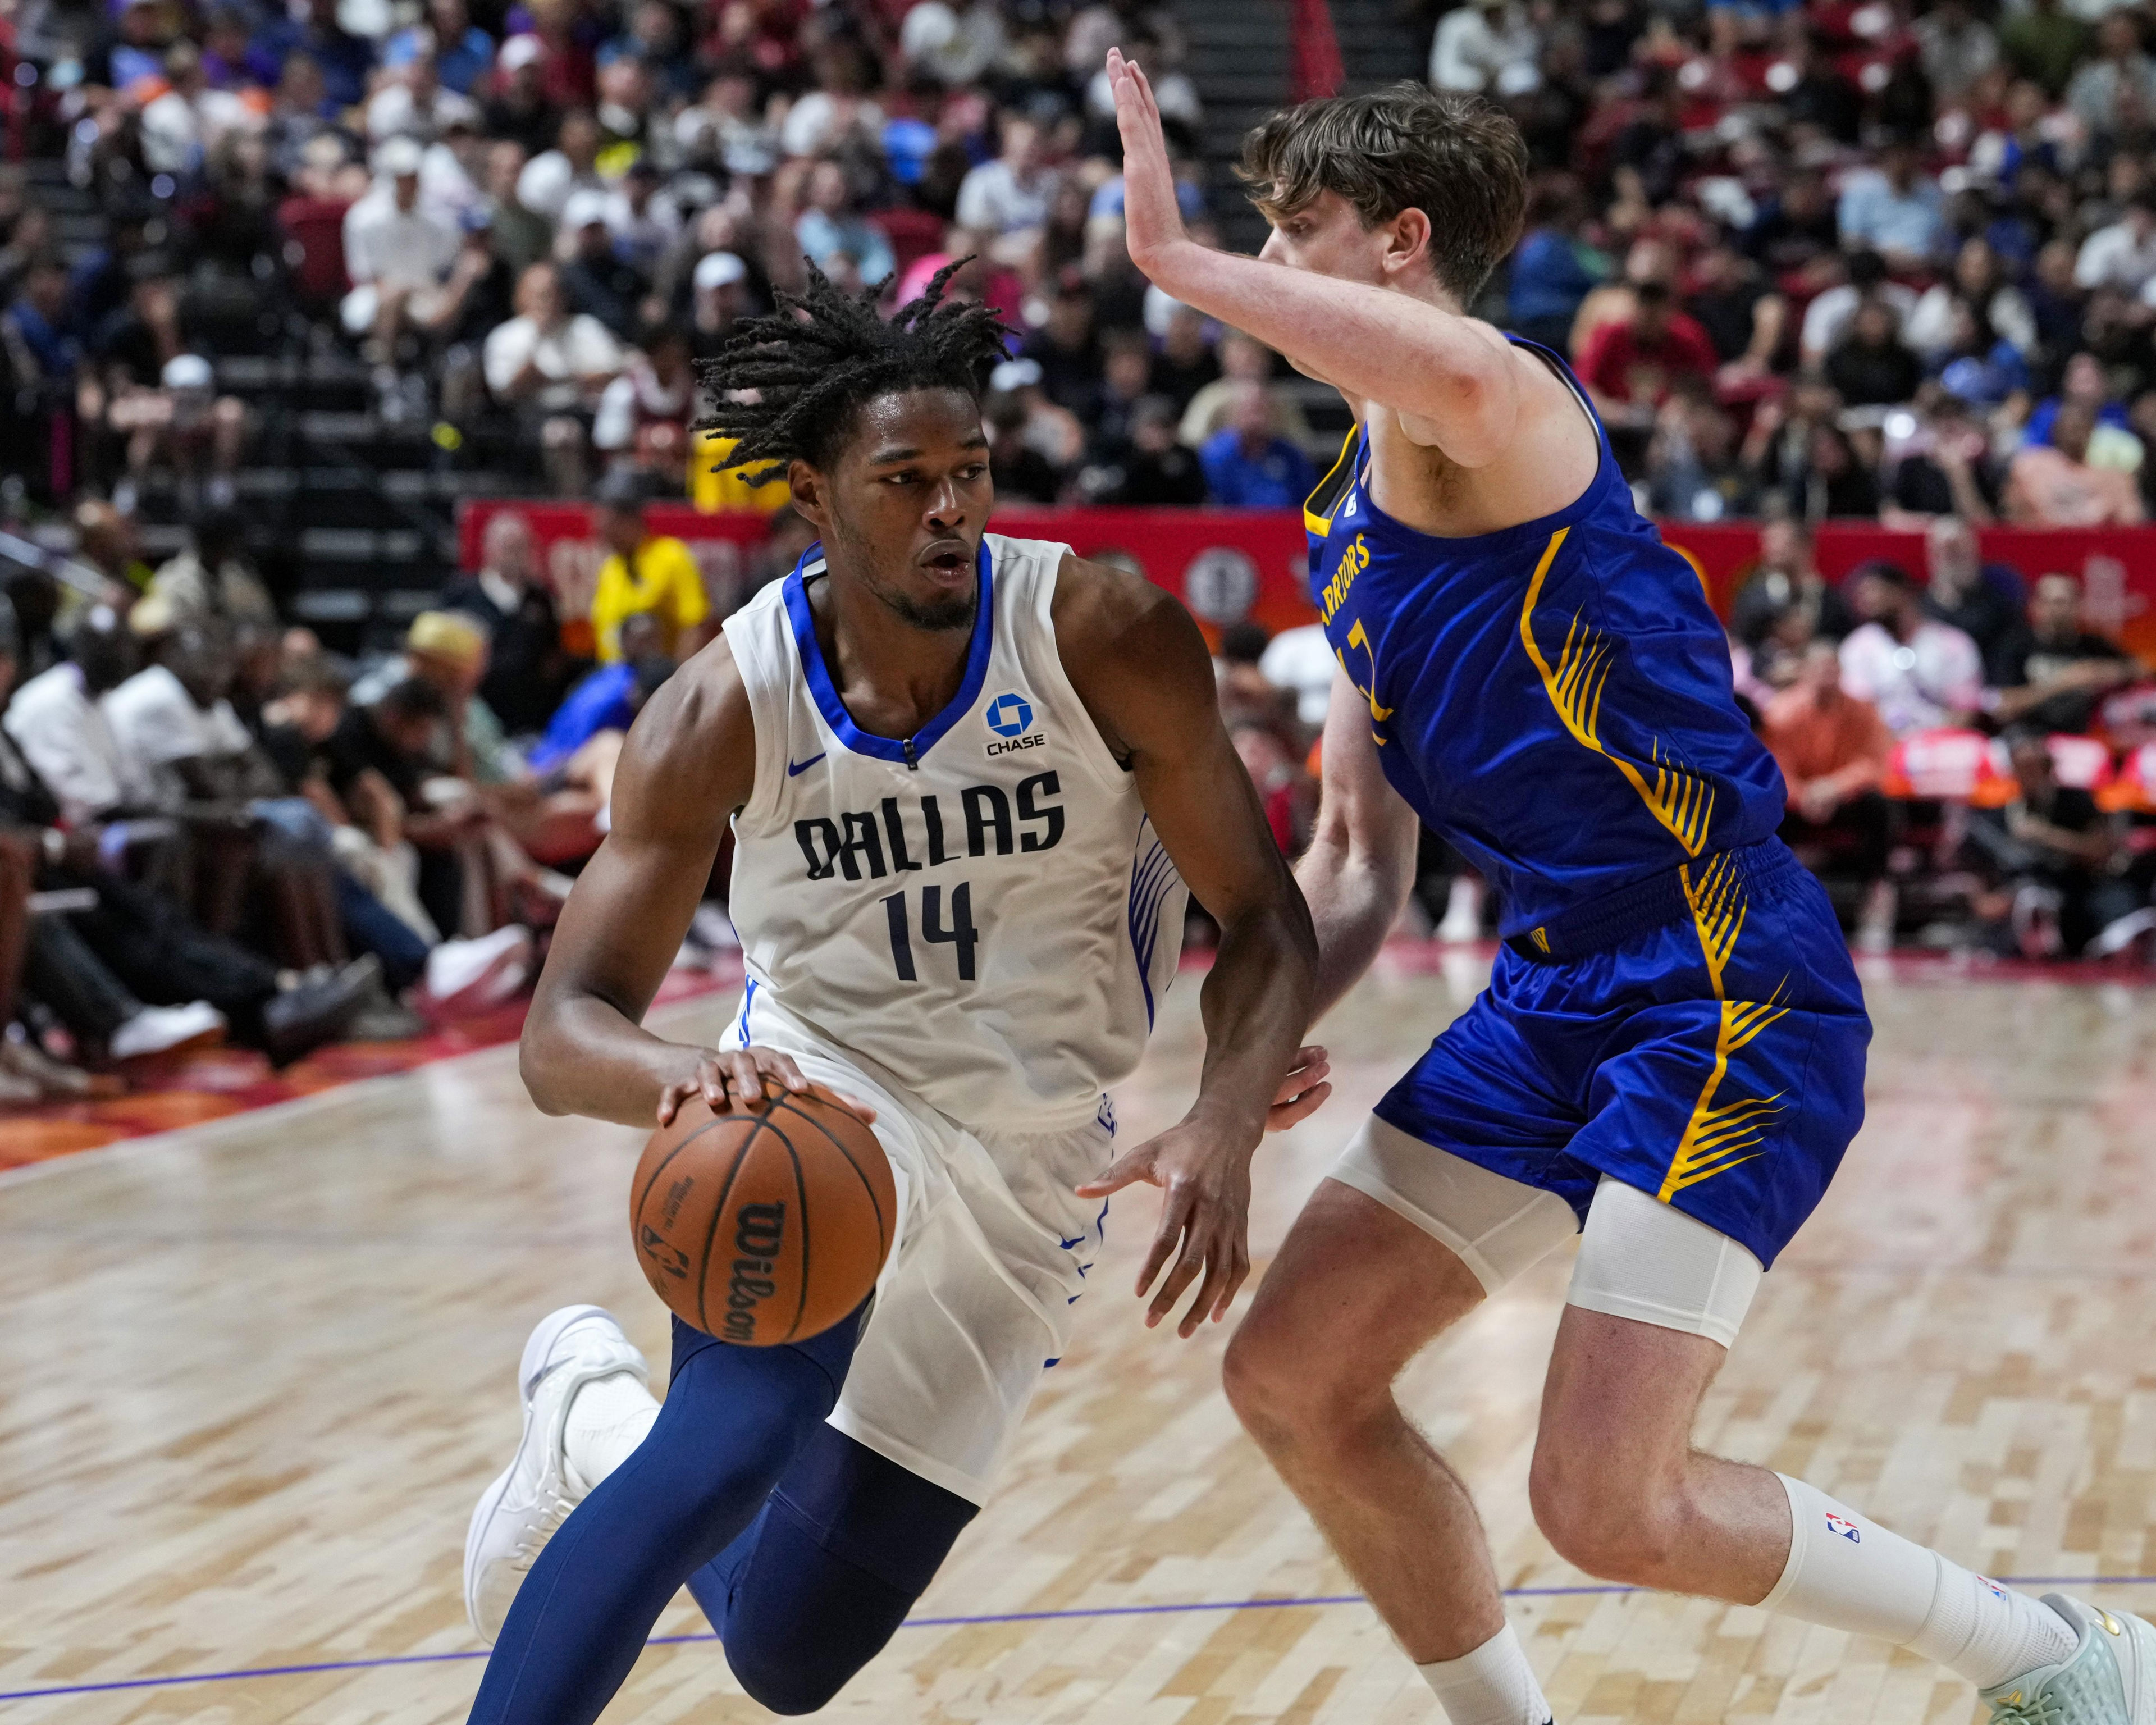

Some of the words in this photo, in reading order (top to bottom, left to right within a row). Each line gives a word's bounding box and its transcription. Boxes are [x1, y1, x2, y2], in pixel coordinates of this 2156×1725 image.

[1321, 532, 1370, 627] RRIORS
[986, 734, 1045, 756] CHASE
[794, 770, 1065, 882] DALLAS
[879, 881, 979, 982] 14
[724, 1199, 786, 1341] Wilson
